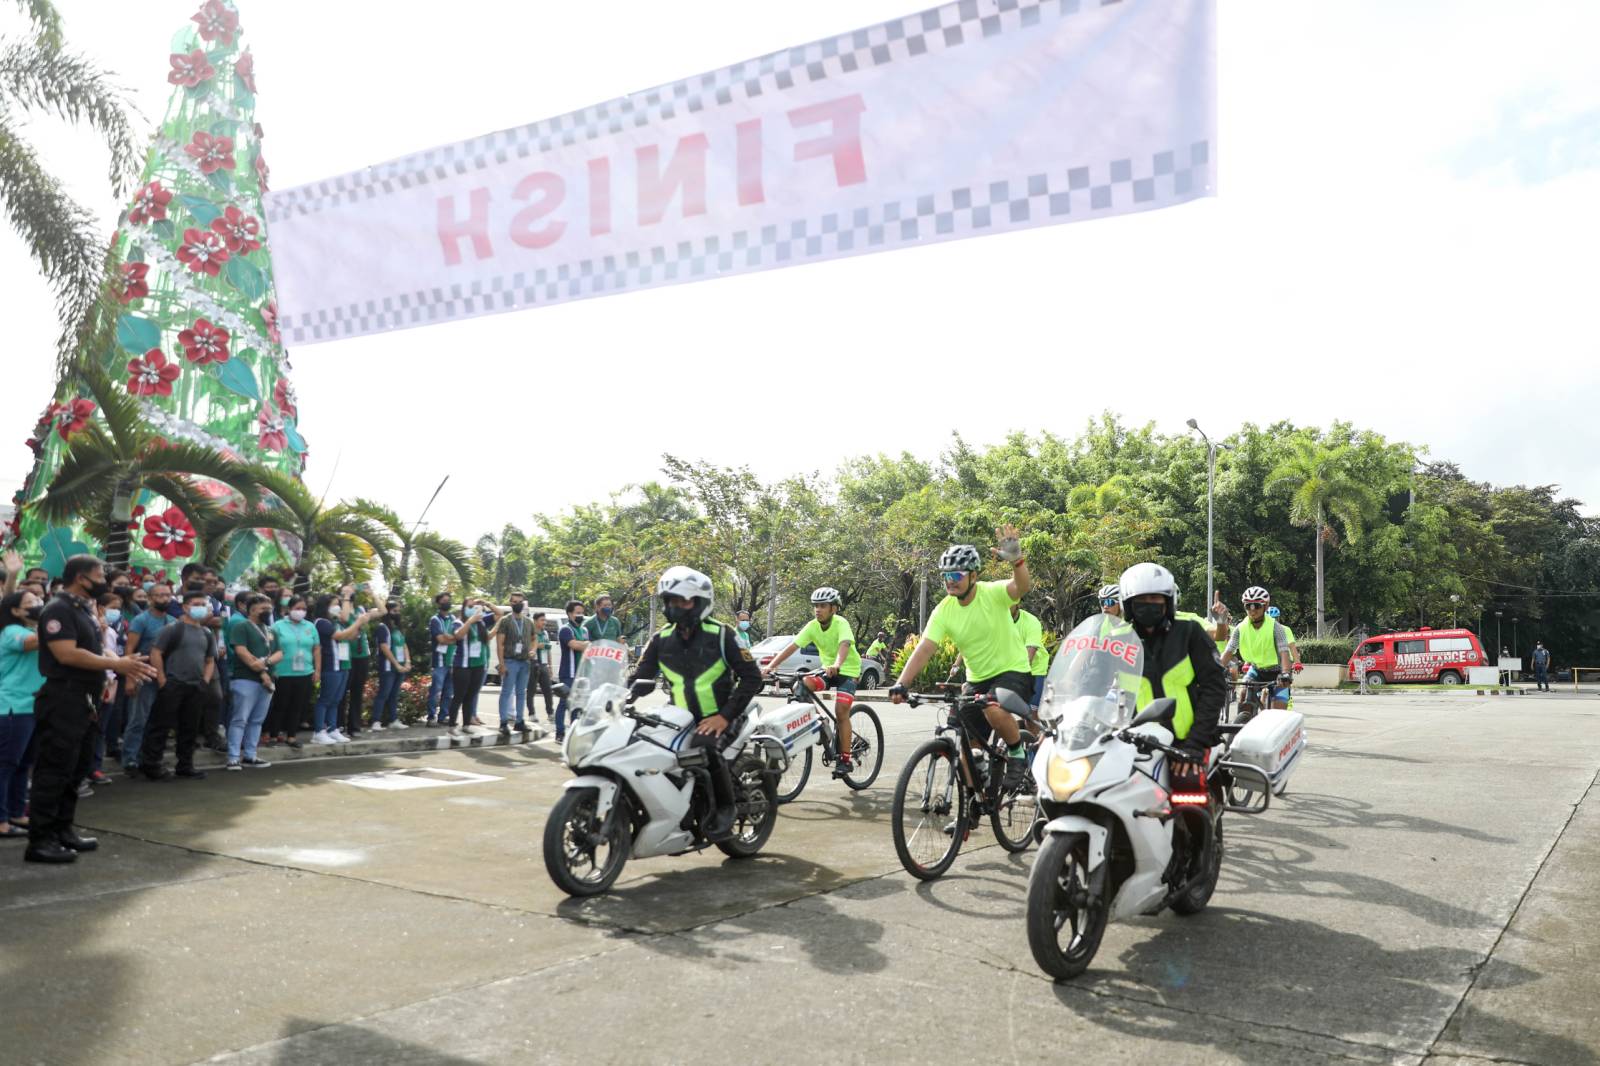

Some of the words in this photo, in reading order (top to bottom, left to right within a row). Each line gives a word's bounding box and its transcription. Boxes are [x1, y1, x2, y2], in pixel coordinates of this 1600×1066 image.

[1062, 635, 1139, 666] POLICE
[1396, 651, 1467, 666] AMBULANCE
[786, 712, 812, 732] POLICE
